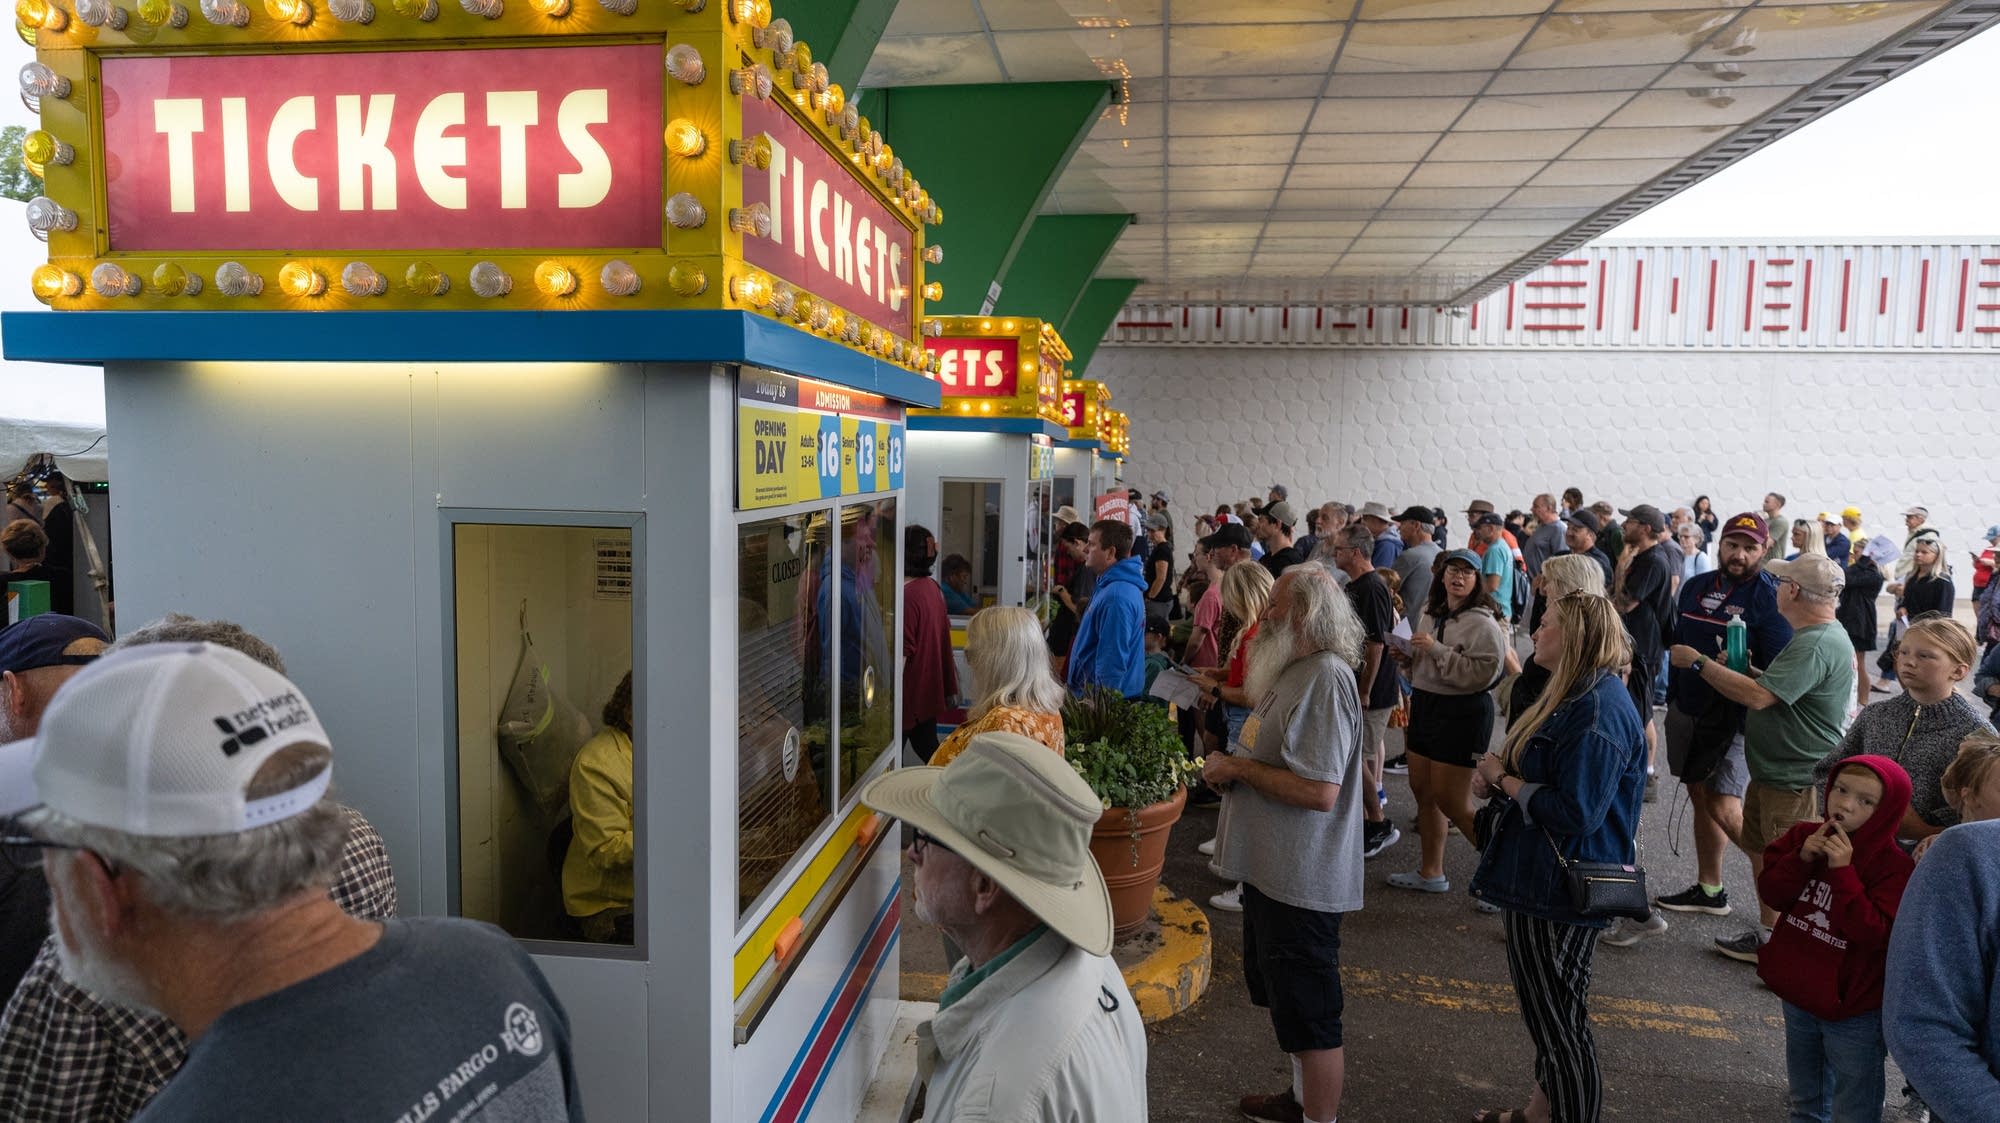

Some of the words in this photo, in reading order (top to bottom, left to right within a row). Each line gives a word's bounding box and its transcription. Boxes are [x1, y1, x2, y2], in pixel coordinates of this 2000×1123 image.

[154, 89, 613, 213] TICKETS
[764, 131, 901, 312] TICKETS
[779, 381, 787, 399] is
[815, 390, 850, 411] ADMISSION
[754, 419, 787, 437] OPENING
[800, 434, 815, 448] Adults
[755, 440, 787, 475] DAY
[817, 428, 839, 477] $16
[855, 431, 874, 475] $13
[887, 434, 902, 474] $13
[772, 557, 801, 584] CLOSED
[396, 1091, 441, 1123] LLS
[437, 1044, 499, 1100] FARGO
